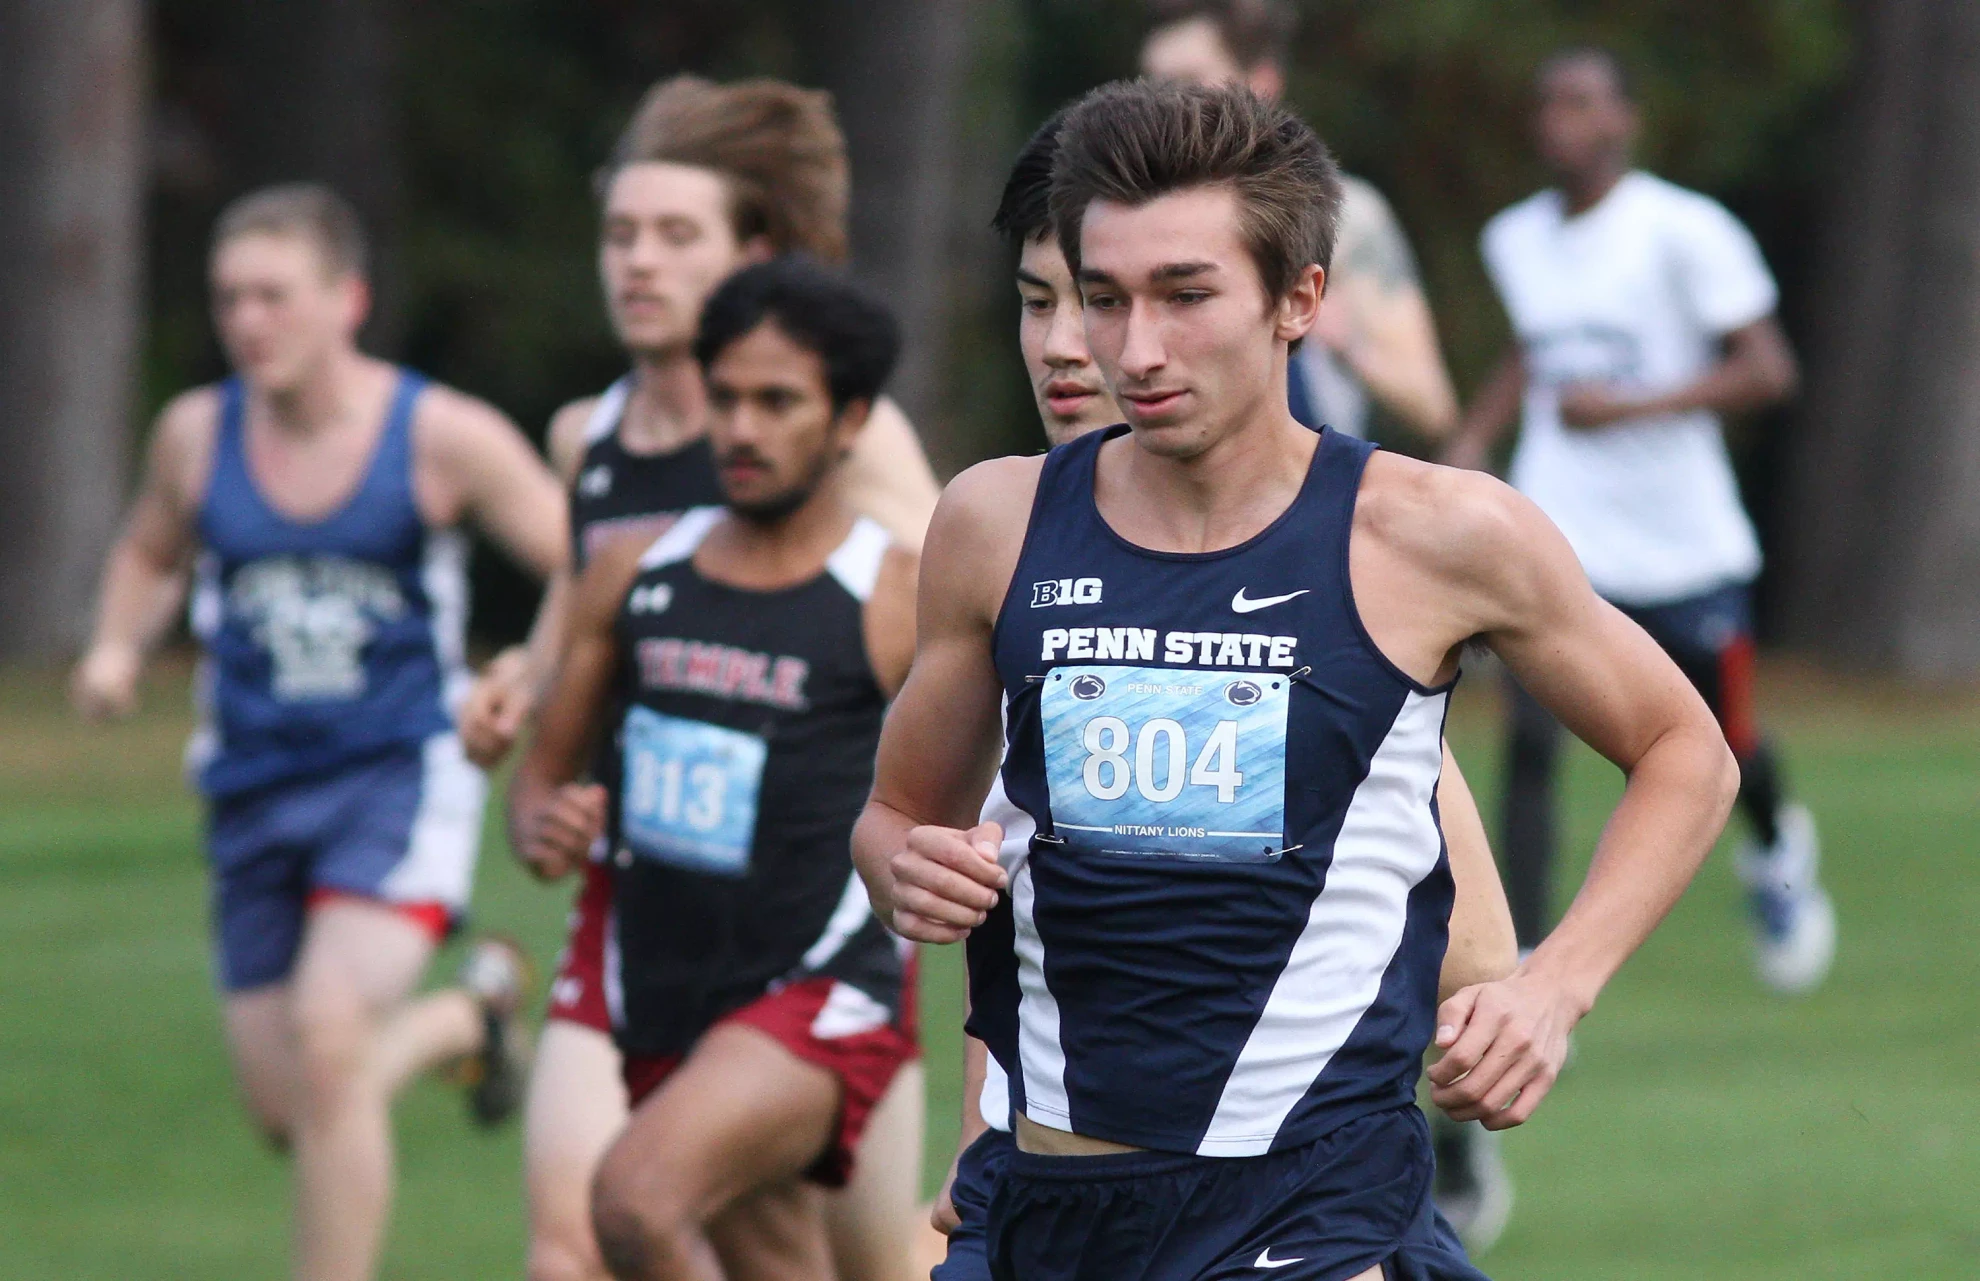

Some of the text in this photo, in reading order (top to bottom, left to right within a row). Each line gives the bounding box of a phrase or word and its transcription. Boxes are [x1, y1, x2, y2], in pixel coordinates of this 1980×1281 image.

[1041, 628, 1298, 666] PENN STATE
[636, 636, 810, 712] TEMPLE
[1127, 683, 1203, 696] PENN STATE
[1082, 716, 1243, 804] 804
[1114, 824, 1205, 838] NITTANY LIONS
